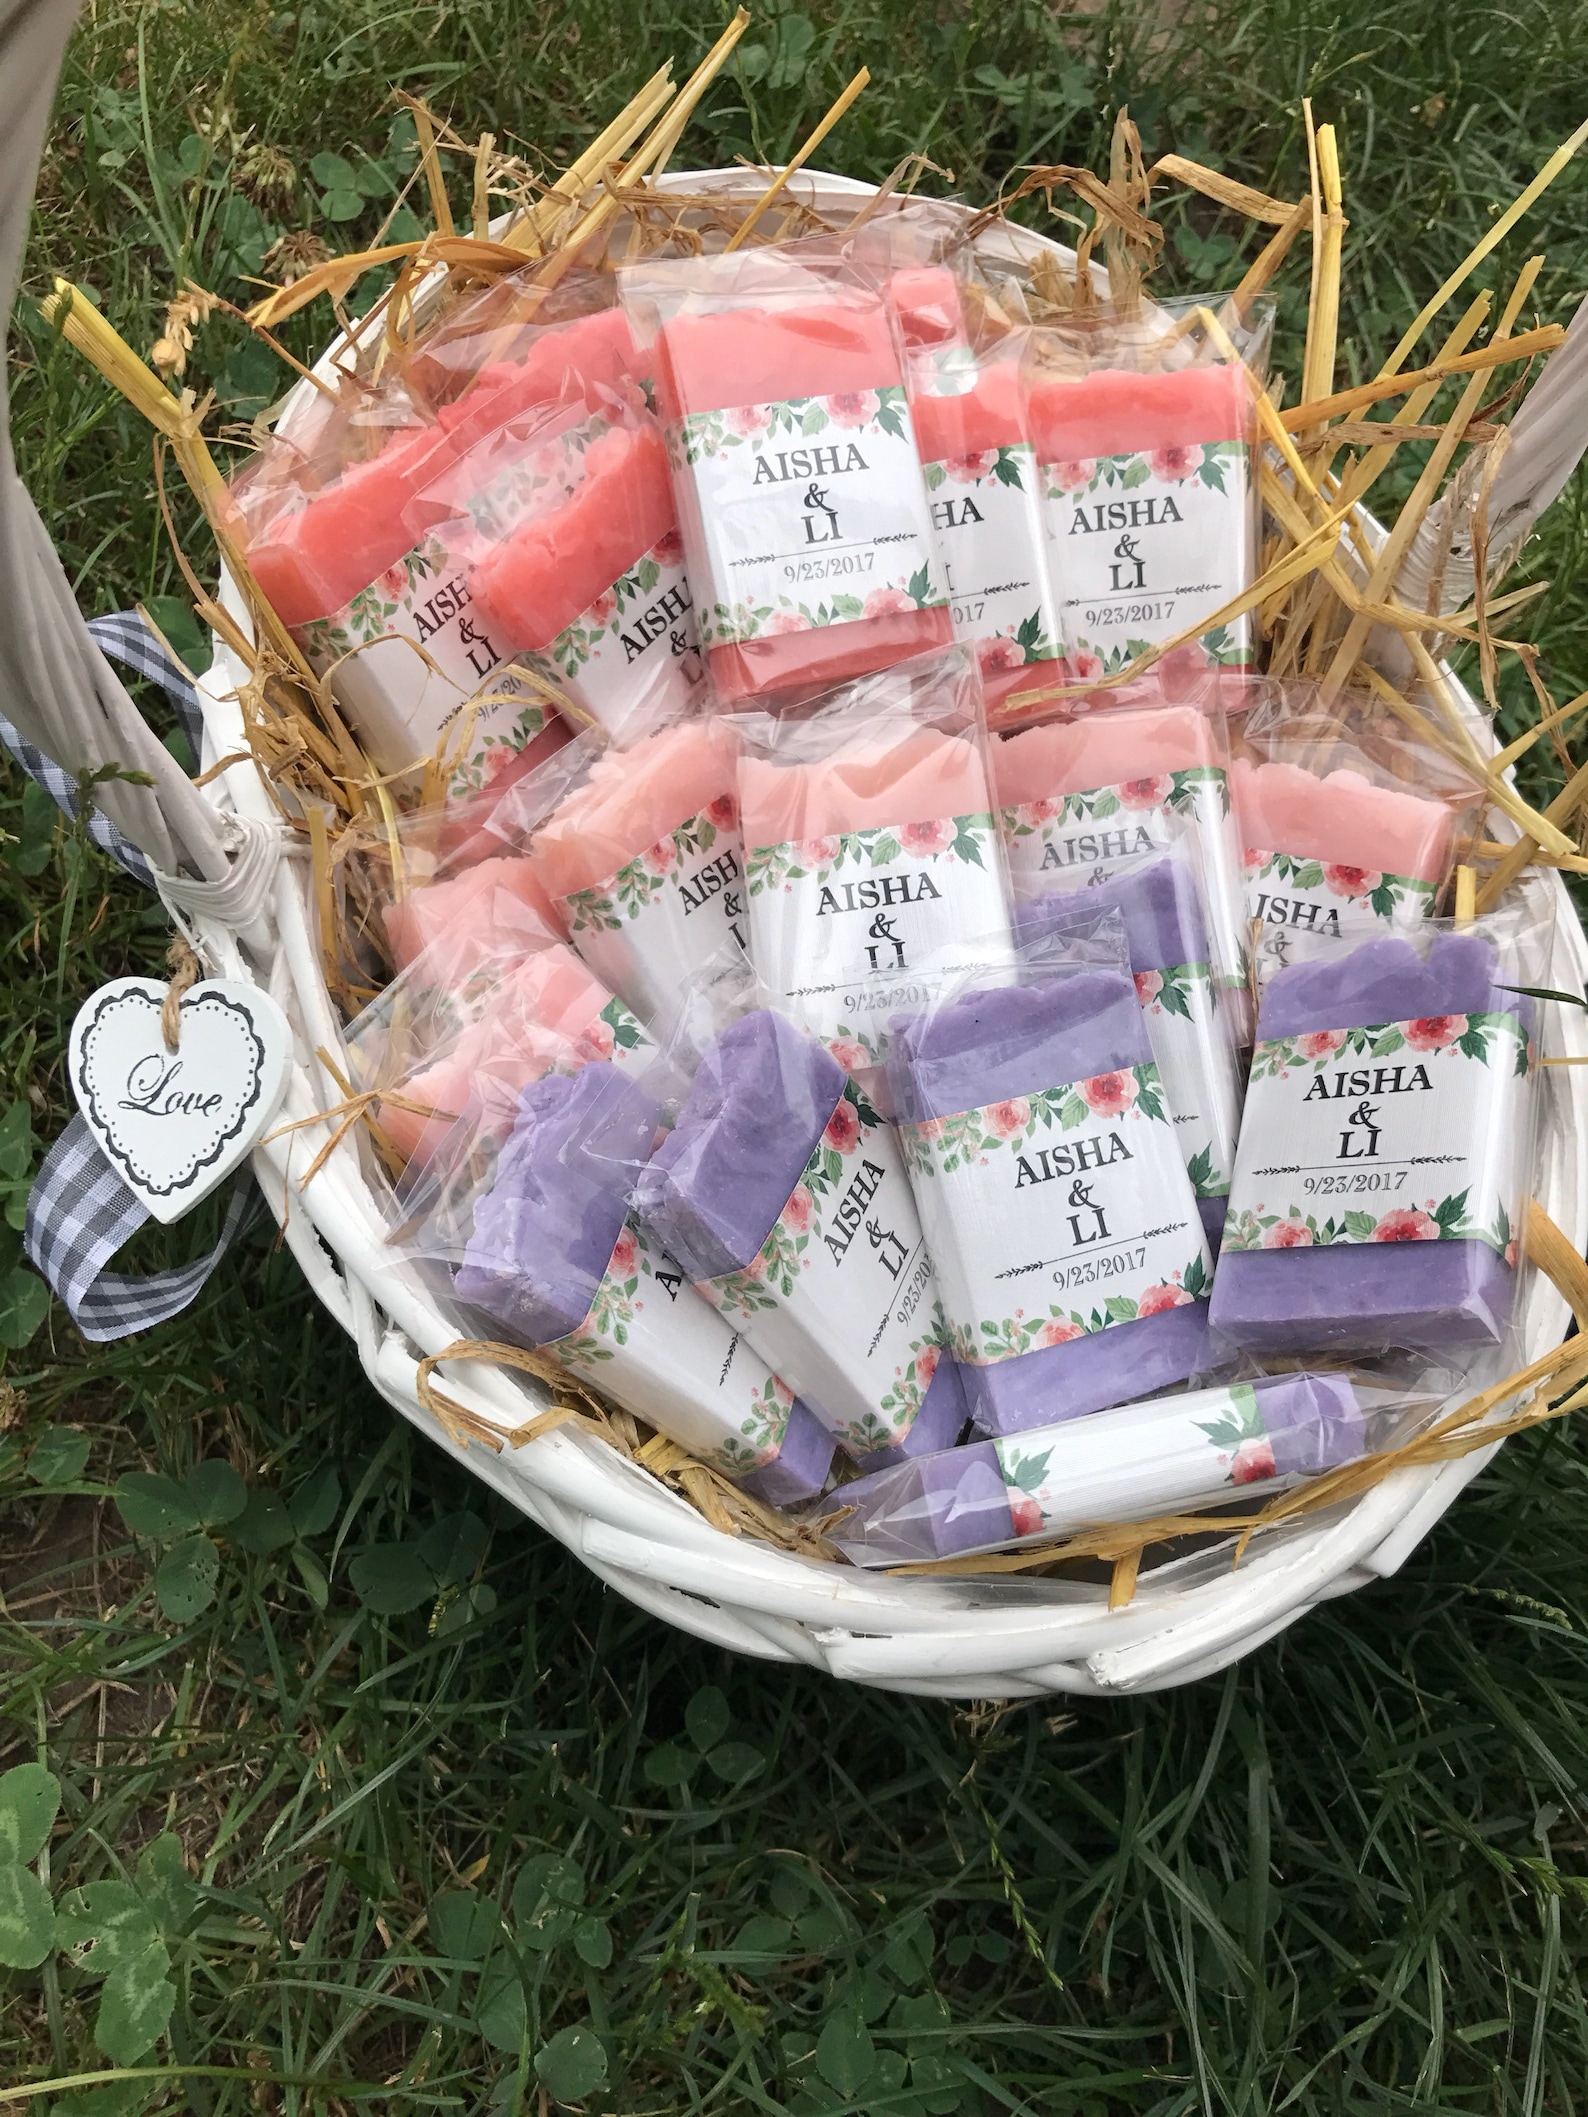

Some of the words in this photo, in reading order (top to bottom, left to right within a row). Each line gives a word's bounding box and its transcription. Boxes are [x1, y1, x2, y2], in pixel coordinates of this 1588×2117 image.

[751, 443, 870, 486] AISHA
[803, 483, 834, 512] &
[1067, 496, 1184, 536] AISHA
[801, 511, 845, 546] LI
[1113, 535, 1143, 563] &
[783, 552, 877, 585] 9/23/2017
[1108, 561, 1149, 592] LI
[412, 572, 474, 645] AISH
[619, 575, 693, 666] AISH
[1085, 601, 1176, 629] 9/23/2017
[458, 617, 486, 645] &
[669, 629, 689, 657] &
[464, 636, 503, 680] LI
[1038, 825, 1157, 871] AISHA
[677, 849, 740, 917] AISH
[815, 871, 943, 916] AISHA
[723, 891, 743, 919] &
[1254, 892, 1343, 939] ISHA
[868, 912, 902, 942] &
[1263, 931, 1293, 964] &
[117, 1053, 224, 1118] Love
[1302, 1064, 1434, 1101] AISHA
[1348, 1100, 1382, 1130] &
[1013, 1131, 1135, 1189] AISHA
[1335, 1128, 1383, 1159] LI
[1067, 1178, 1101, 1209] &
[1303, 1170, 1409, 1196] 9/23/2017
[823, 1159, 886, 1268] AISHA
[865, 1215, 891, 1249] &
[1066, 1206, 1113, 1247] LI
[877, 1230, 911, 1282] LI
[1052, 1246, 1147, 1291] 9/23/2017
[896, 1253, 931, 1328] 9/23/20
